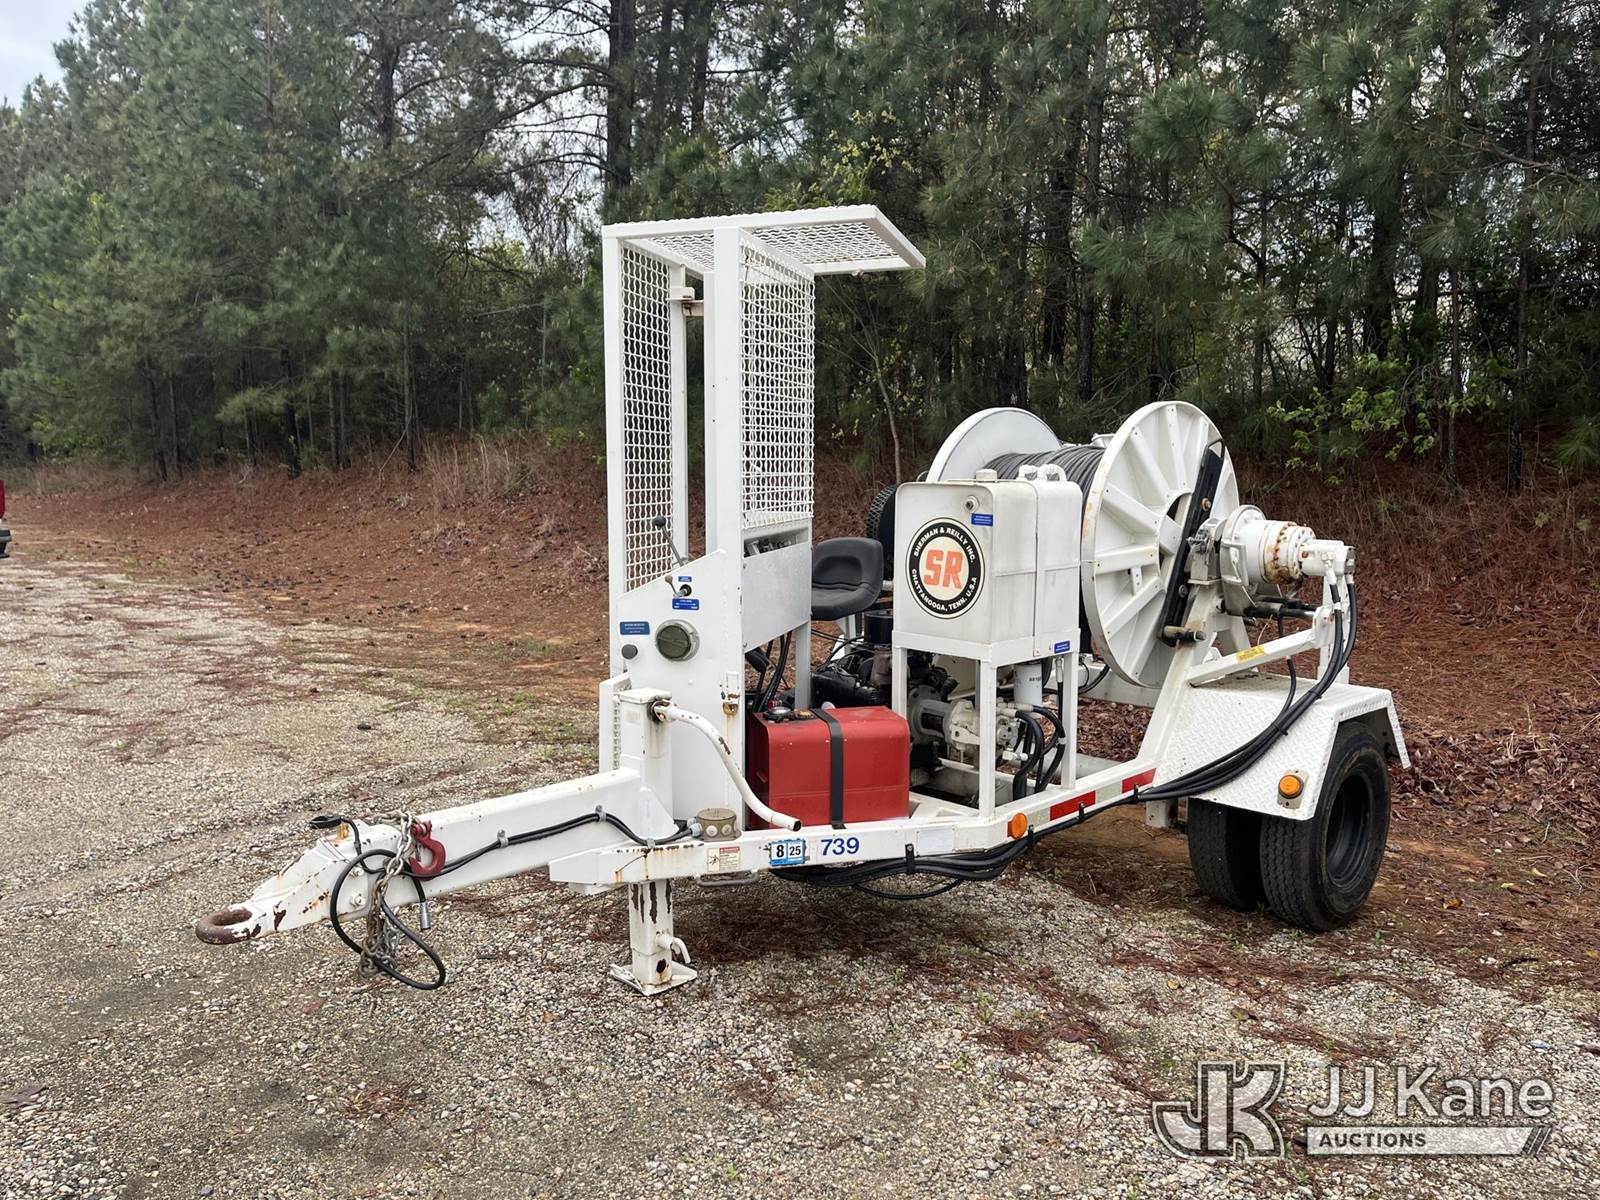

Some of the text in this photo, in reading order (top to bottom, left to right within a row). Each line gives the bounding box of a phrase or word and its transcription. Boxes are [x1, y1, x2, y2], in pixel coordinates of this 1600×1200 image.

[913, 526, 976, 563] SHERMAN & REILLY INC.
[923, 549, 964, 589] SR
[911, 568, 948, 611] CHATTANOOGA,
[948, 598, 968, 610] TENN.
[776, 844, 801, 858] 8 25
[820, 837, 860, 856] 739
